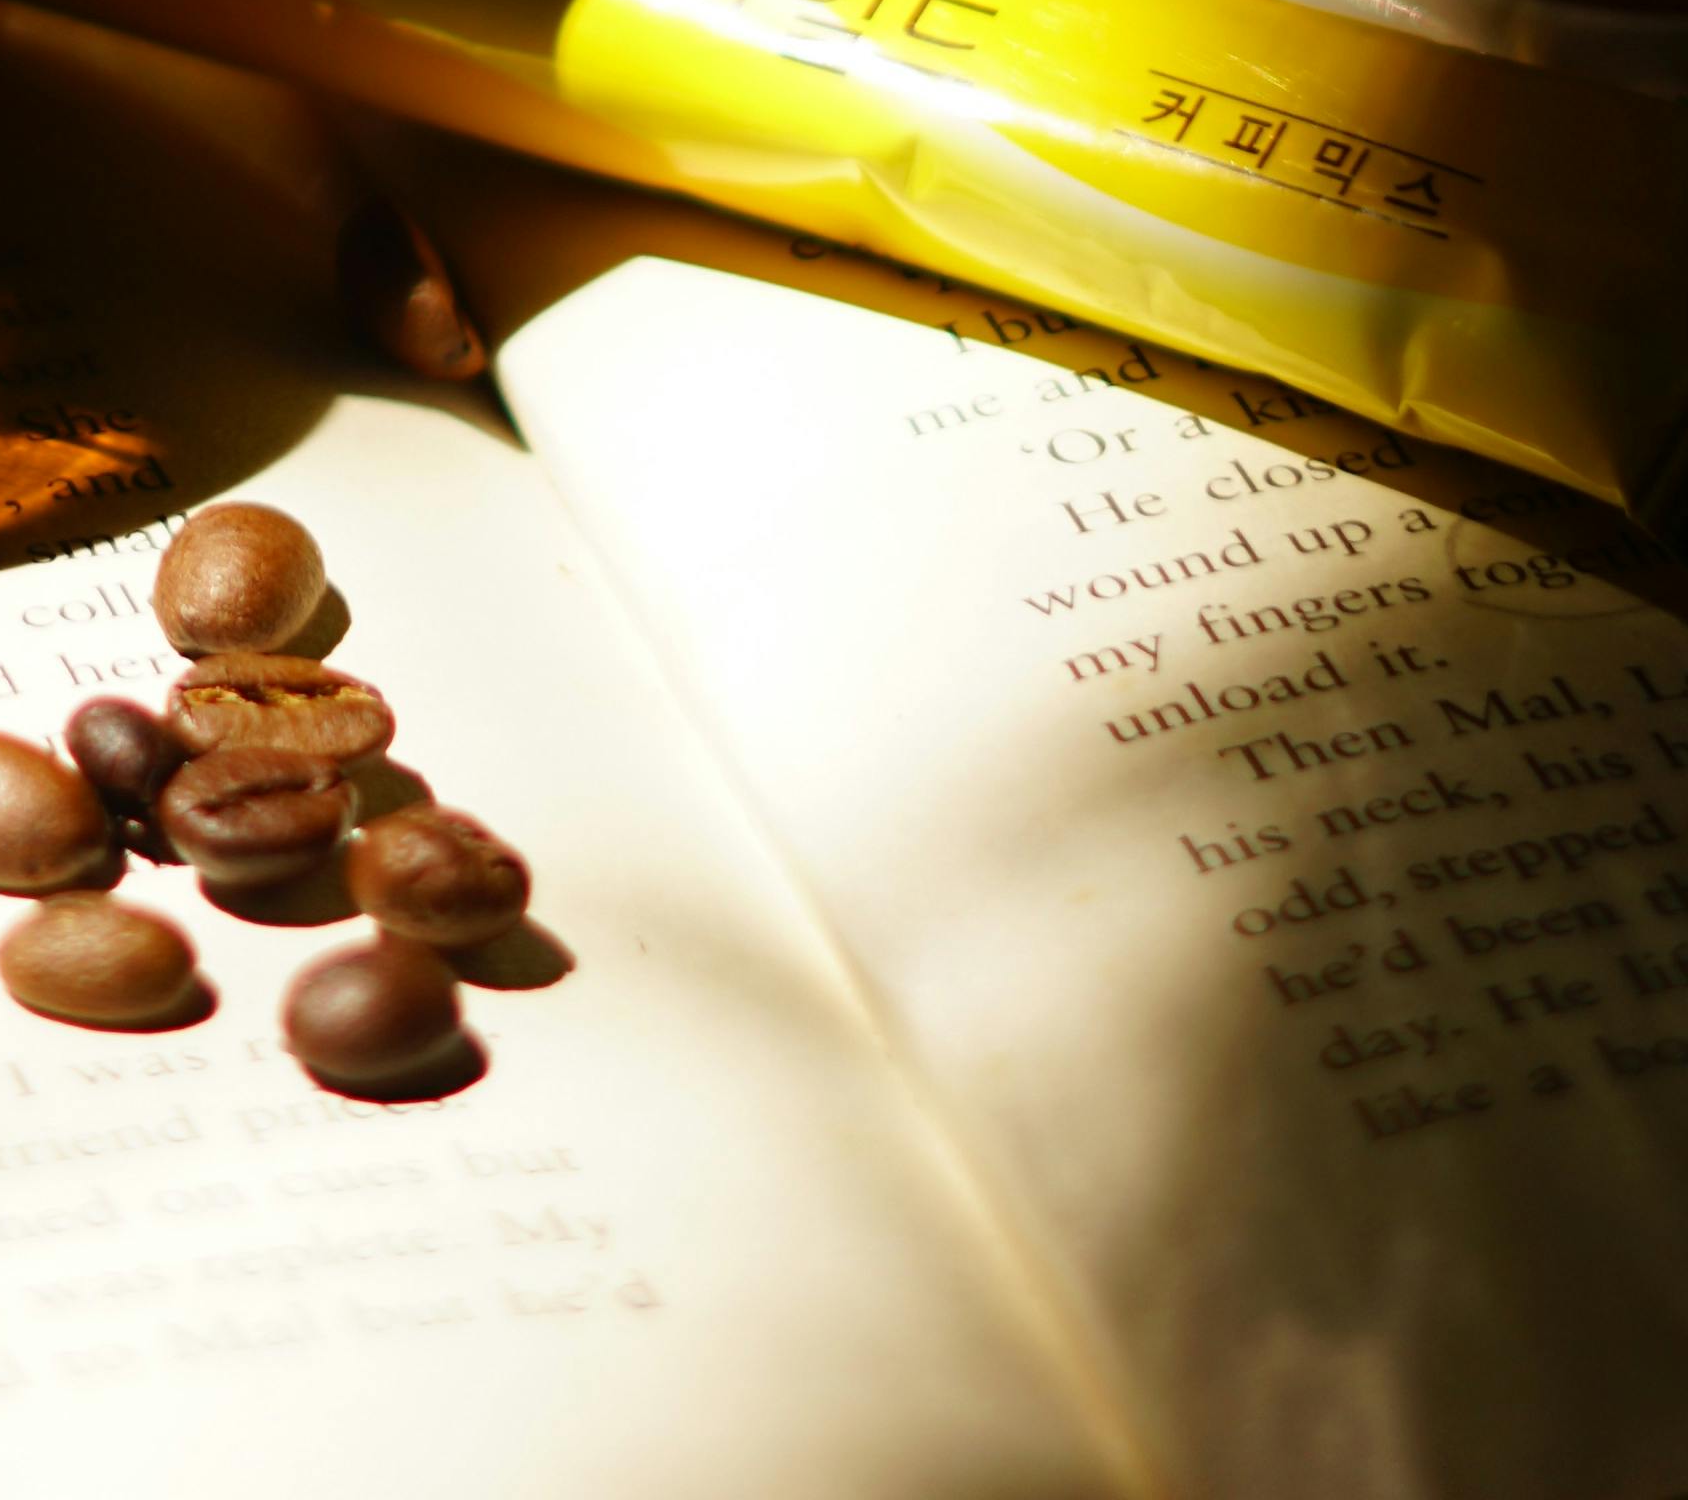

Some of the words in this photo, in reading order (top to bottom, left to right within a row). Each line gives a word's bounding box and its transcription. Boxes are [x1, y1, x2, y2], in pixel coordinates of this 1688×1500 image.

[1137, 86, 1448, 218] 커피믹스
[16, 396, 142, 445] She
[1034, 342, 1164, 406] and
[1172, 412, 1214, 444] a
[44, 452, 176, 502] and
[1060, 486, 1168, 538] He
[1202, 430, 1418, 506] closed
[1020, 522, 1268, 622] wound
[1280, 512, 1376, 560] up
[1396, 502, 1442, 538] a
[54, 646, 182, 692] her
[1060, 628, 1168, 686] my
[1194, 568, 1434, 652] fingers
[1100, 648, 1352, 752] unload
[1368, 638, 1454, 682] it.
[1216, 714, 1416, 786] Then
[1436, 674, 1614, 740] Mal,
[1176, 820, 1296, 878] his
[1314, 768, 1514, 840] neck,
[1520, 742, 1638, 794] his
[1228, 864, 1400, 942] odd,
[1404, 800, 1684, 894] stepped
[1260, 924, 1438, 1010] he'd
[1442, 894, 1630, 962] been
[1316, 1012, 1474, 1076] day.
